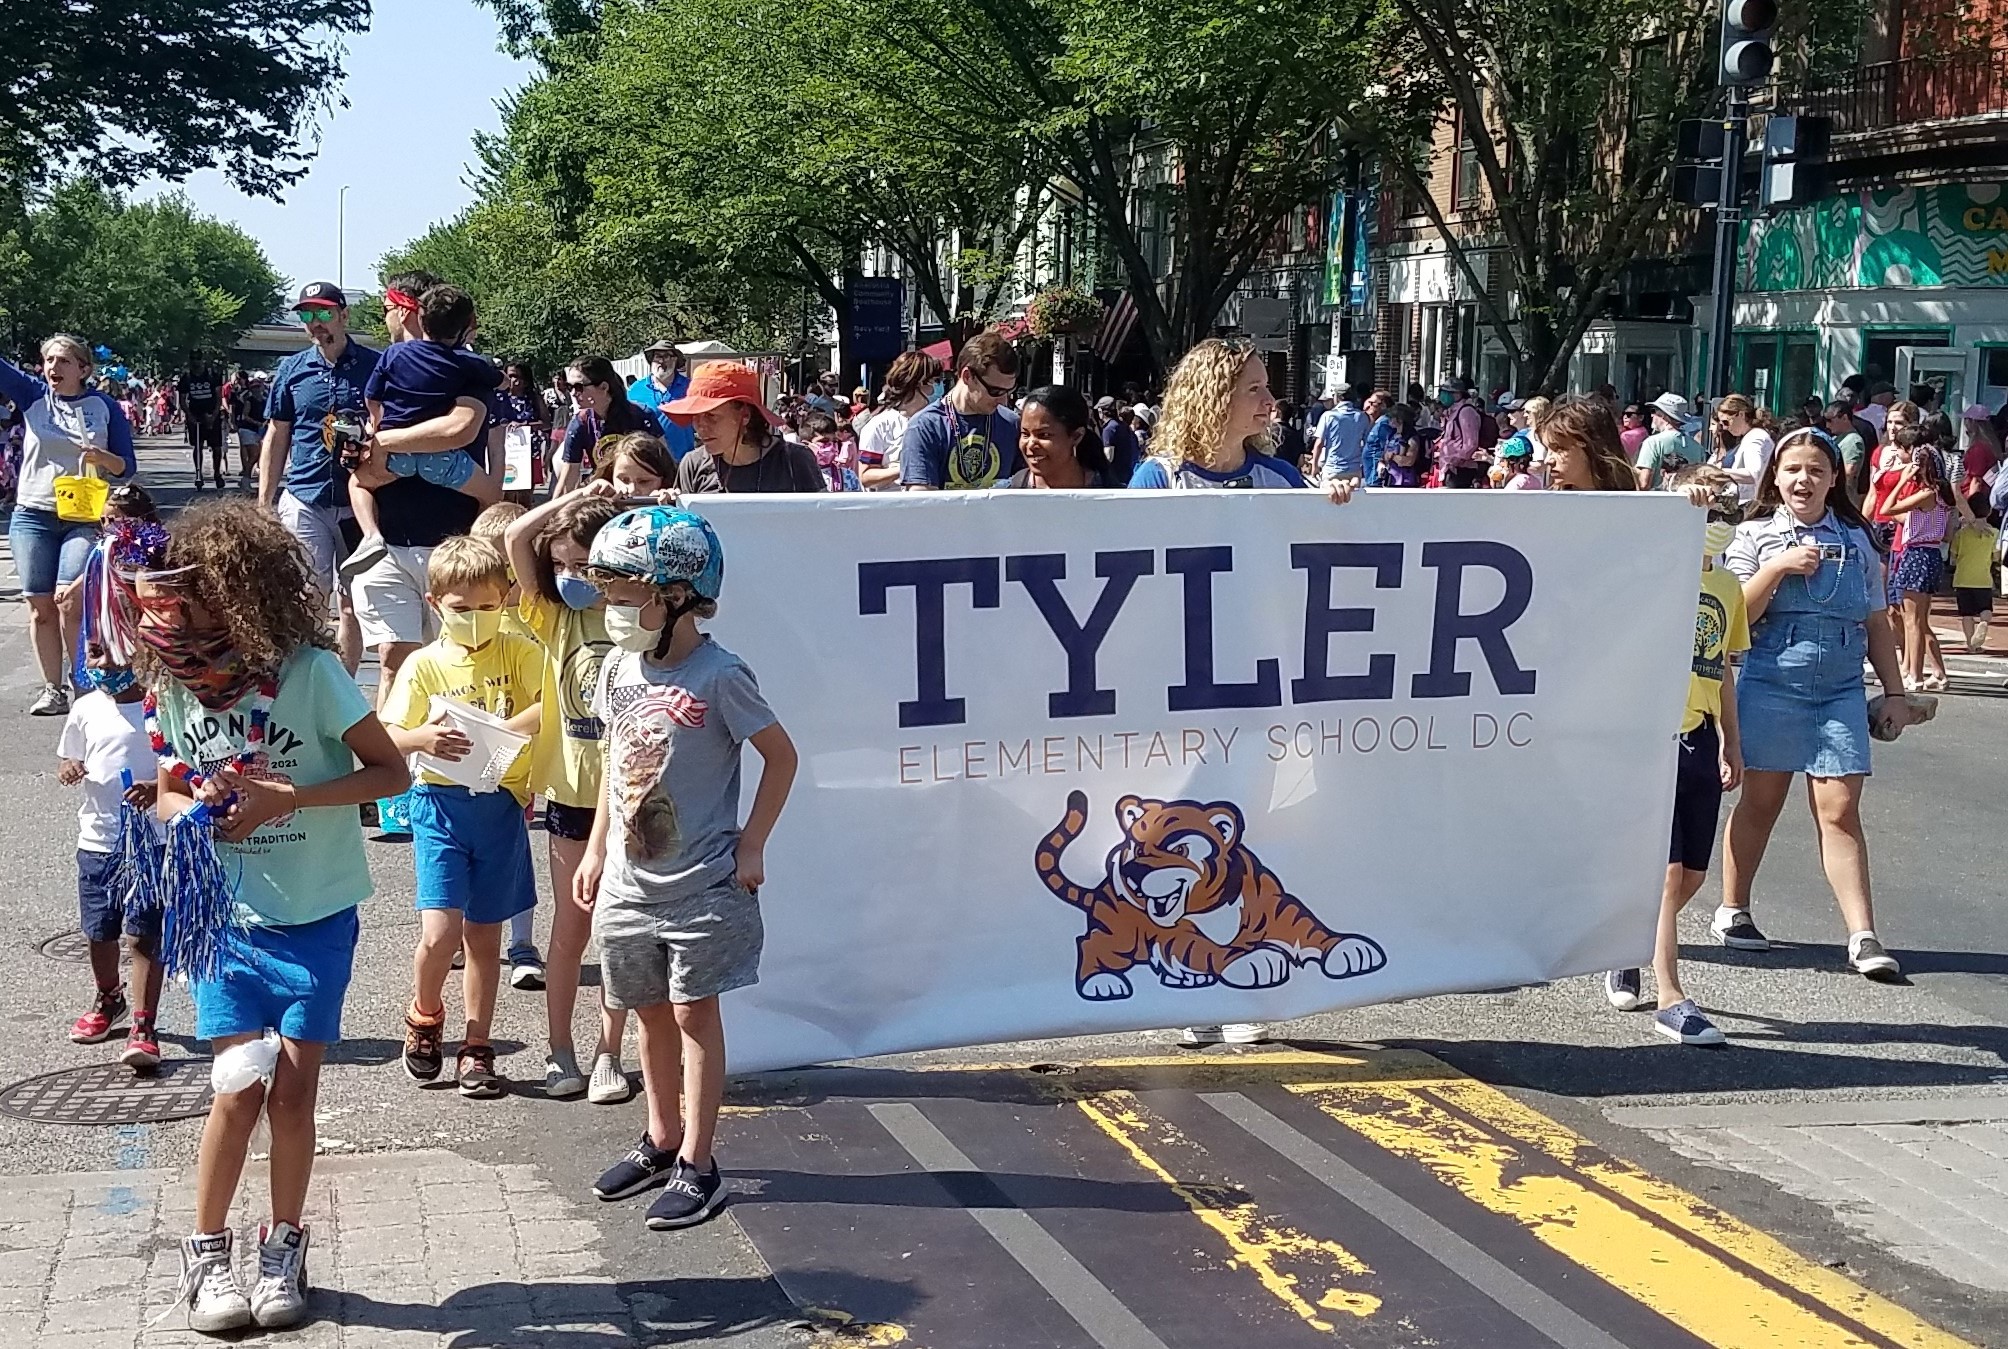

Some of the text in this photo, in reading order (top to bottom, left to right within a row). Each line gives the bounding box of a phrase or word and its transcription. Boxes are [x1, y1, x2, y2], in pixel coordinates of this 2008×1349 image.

[853, 290, 894, 298] Community
[853, 325, 890, 333] Navy Yard
[858, 540, 1537, 728] TYLER
[228, 713, 304, 756] NVY
[898, 711, 1535, 785] ELEMENTARY SCHOOL DC
[270, 759, 298, 769] 2021
[247, 832, 307, 846] TRADITION
